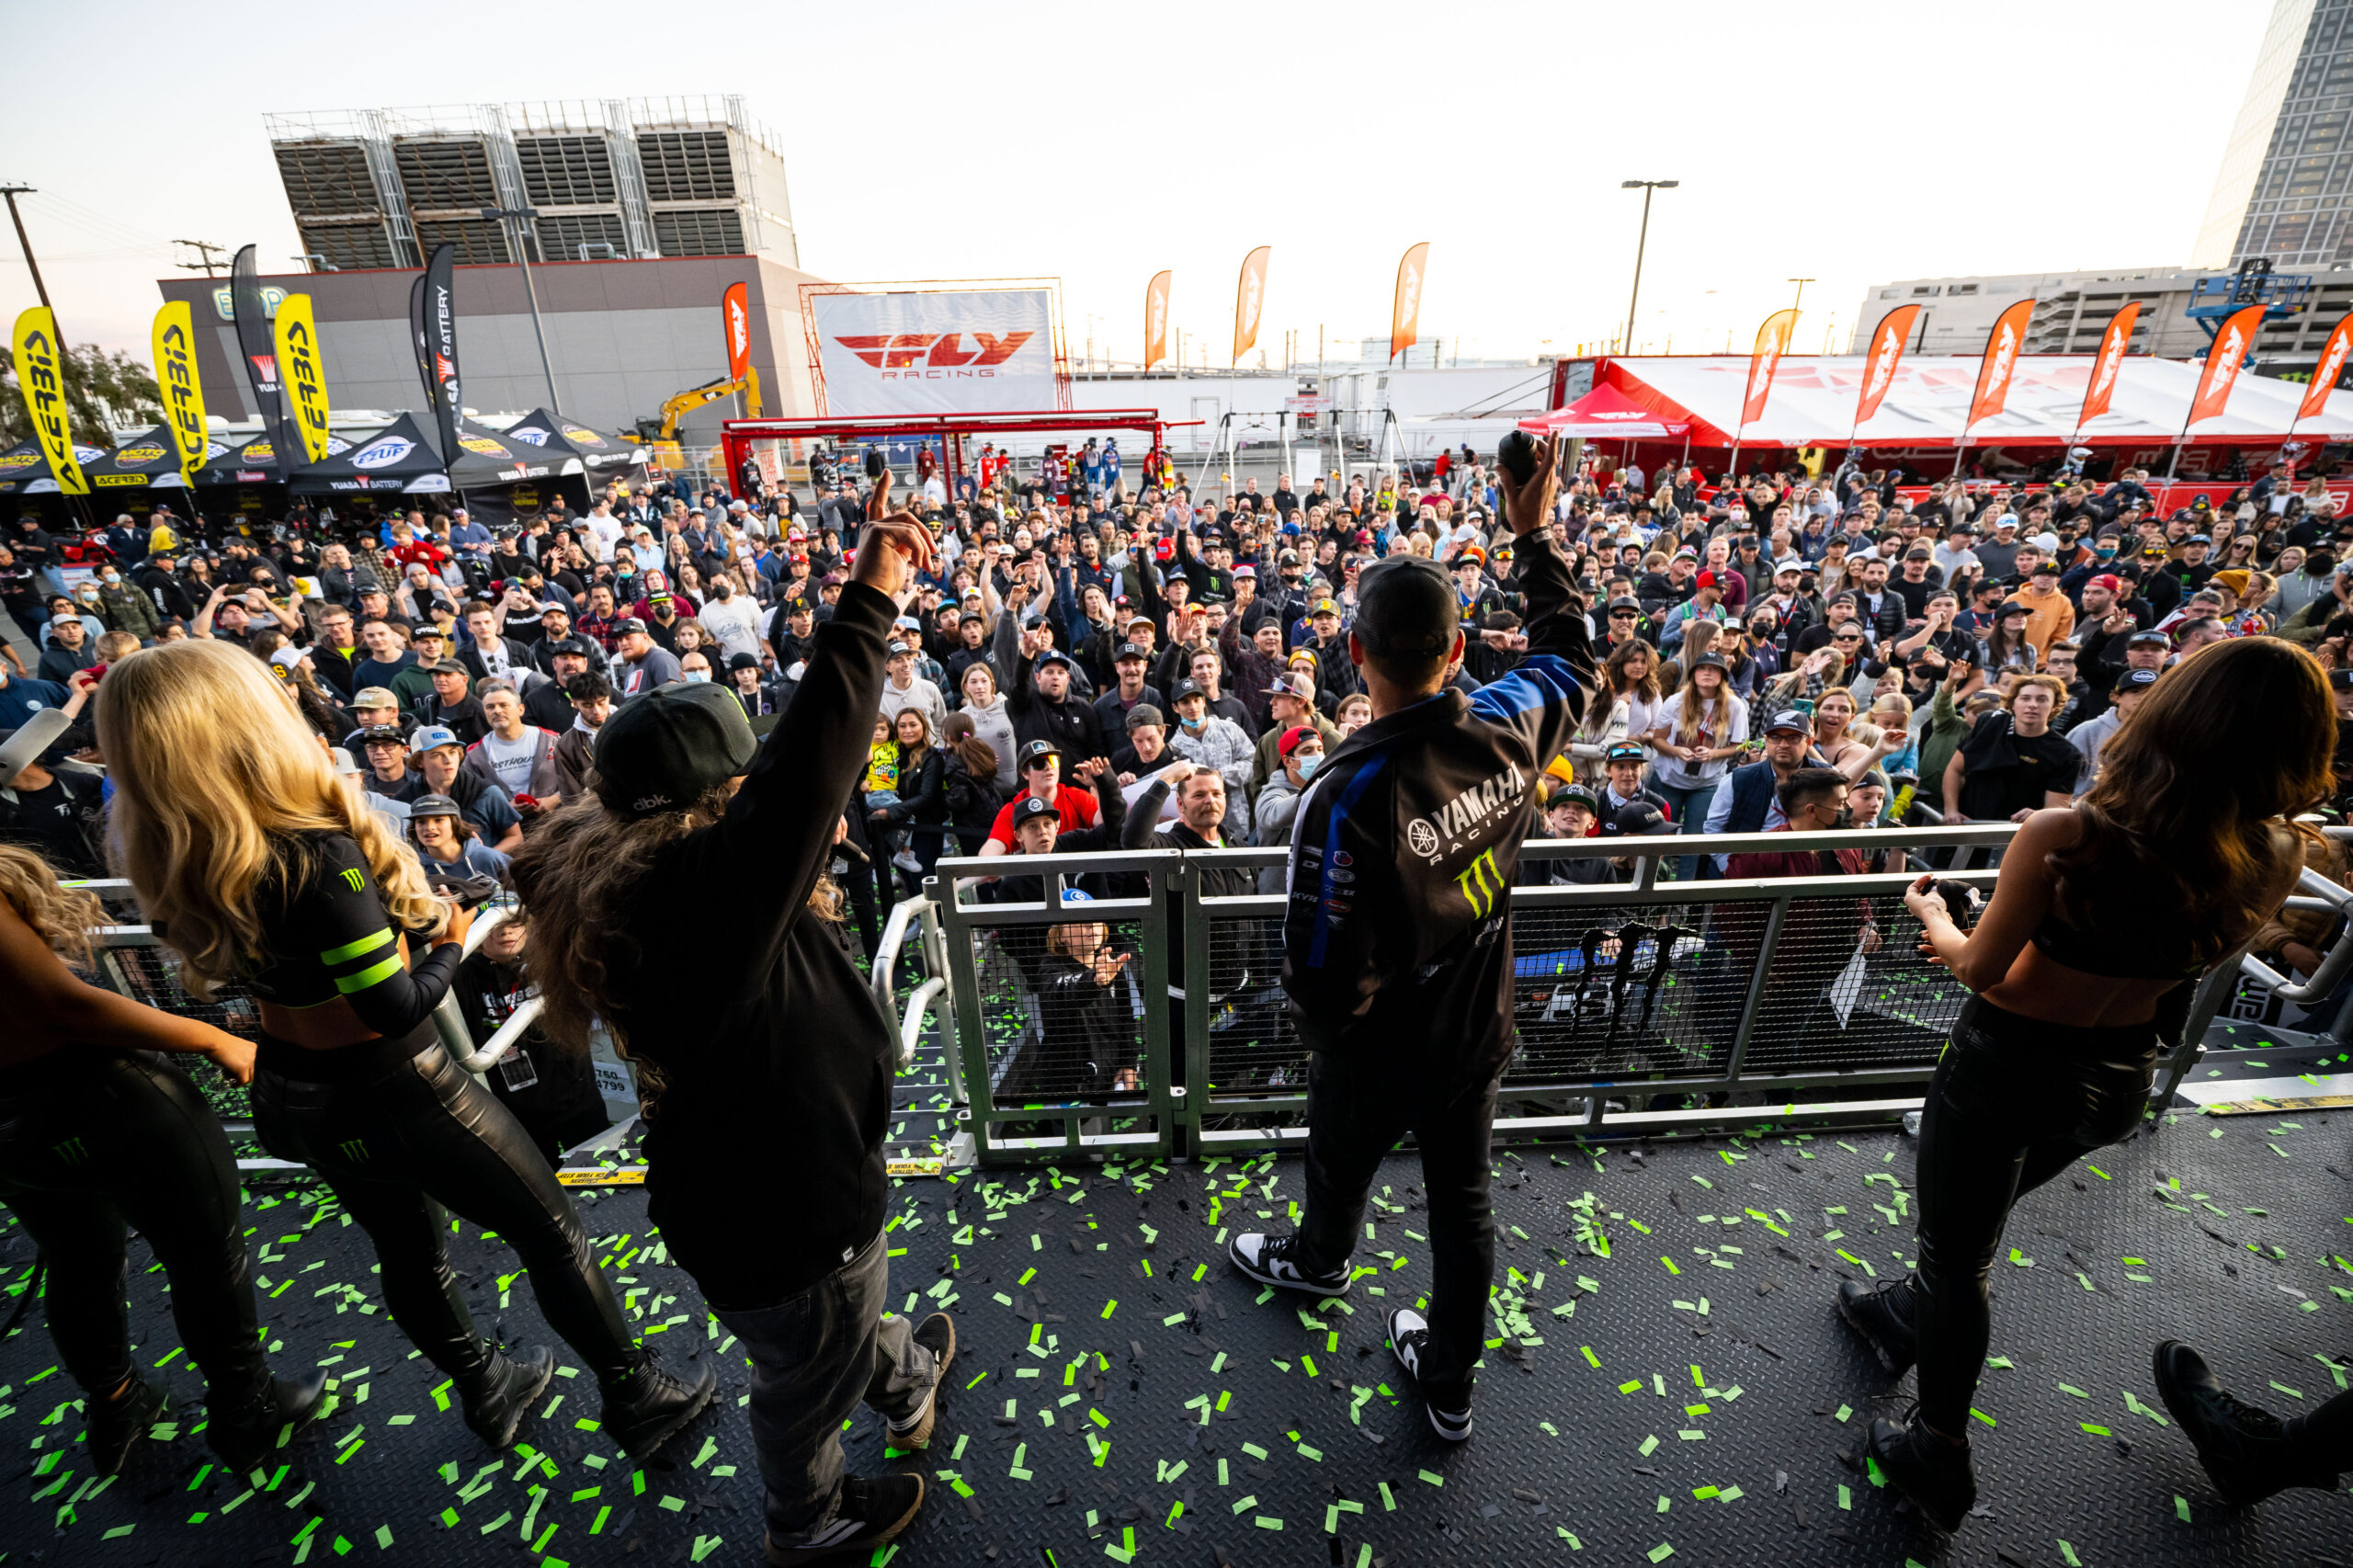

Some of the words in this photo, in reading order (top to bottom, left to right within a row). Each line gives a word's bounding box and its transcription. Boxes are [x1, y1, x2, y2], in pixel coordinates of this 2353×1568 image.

[834, 332, 1035, 369] FLY
[882, 369, 995, 380] RACING
[288, 321, 325, 458] ERBIS
[98, 476, 145, 485] ACERBIS
[330, 481, 360, 490] YUASA
[369, 480, 404, 489] BATTERY
[272, 665, 287, 678] S
[1432, 760, 1526, 839] YAMAHA
[1429, 794, 1523, 867] RACING
